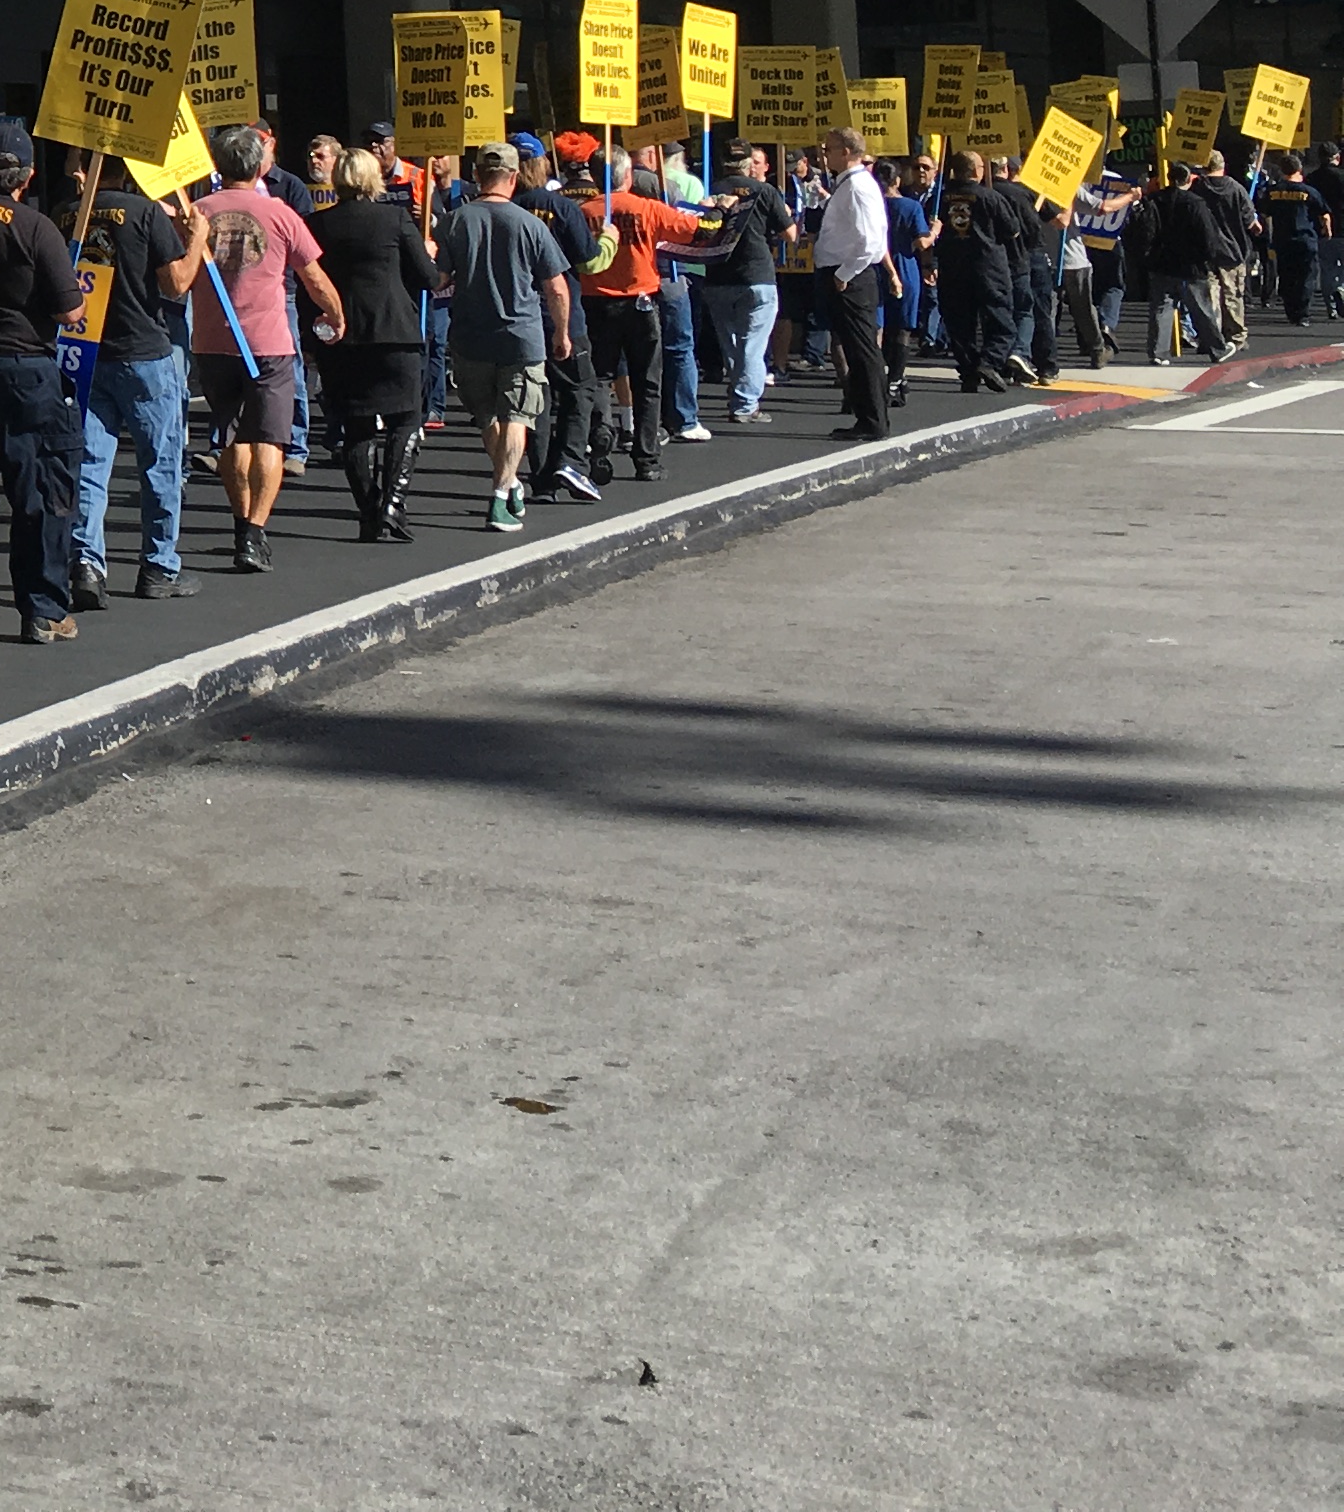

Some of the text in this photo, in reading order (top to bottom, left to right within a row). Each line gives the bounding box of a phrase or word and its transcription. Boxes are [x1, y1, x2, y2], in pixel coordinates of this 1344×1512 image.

[91, 4, 169, 41] Record
[204, 20, 235, 37] the
[583, 20, 633, 39] Share Price
[70, 29, 173, 73] Profit$$$.
[401, 43, 464, 62] Share Price
[469, 39, 495, 55] ice
[592, 41, 623, 59] Doesn't
[688, 38, 729, 63] We Are
[79, 60, 154, 97] It's Our
[206, 64, 238, 81] Our
[411, 66, 451, 84] Doesn't
[585, 61, 631, 80] Save Lives.
[689, 64, 727, 88] United
[750, 67, 804, 81] Deck the
[191, 85, 246, 106] Share
[402, 88, 459, 107] Save Lives.
[593, 82, 608, 98] We
[762, 84, 793, 96] Halls
[84, 90, 134, 124] Turn.
[751, 99, 804, 112] With Our
[852, 99, 897, 110] Friendly
[412, 111, 446, 128] We do.
[653, 105, 681, 123] This!
[747, 114, 808, 127] Fair Share
[862, 125, 889, 136] Free.
[975, 118, 991, 129] No
[1256, 116, 1283, 132] Peace
[967, 133, 1003, 145] Peace
[1052, 129, 1083, 154] Record
